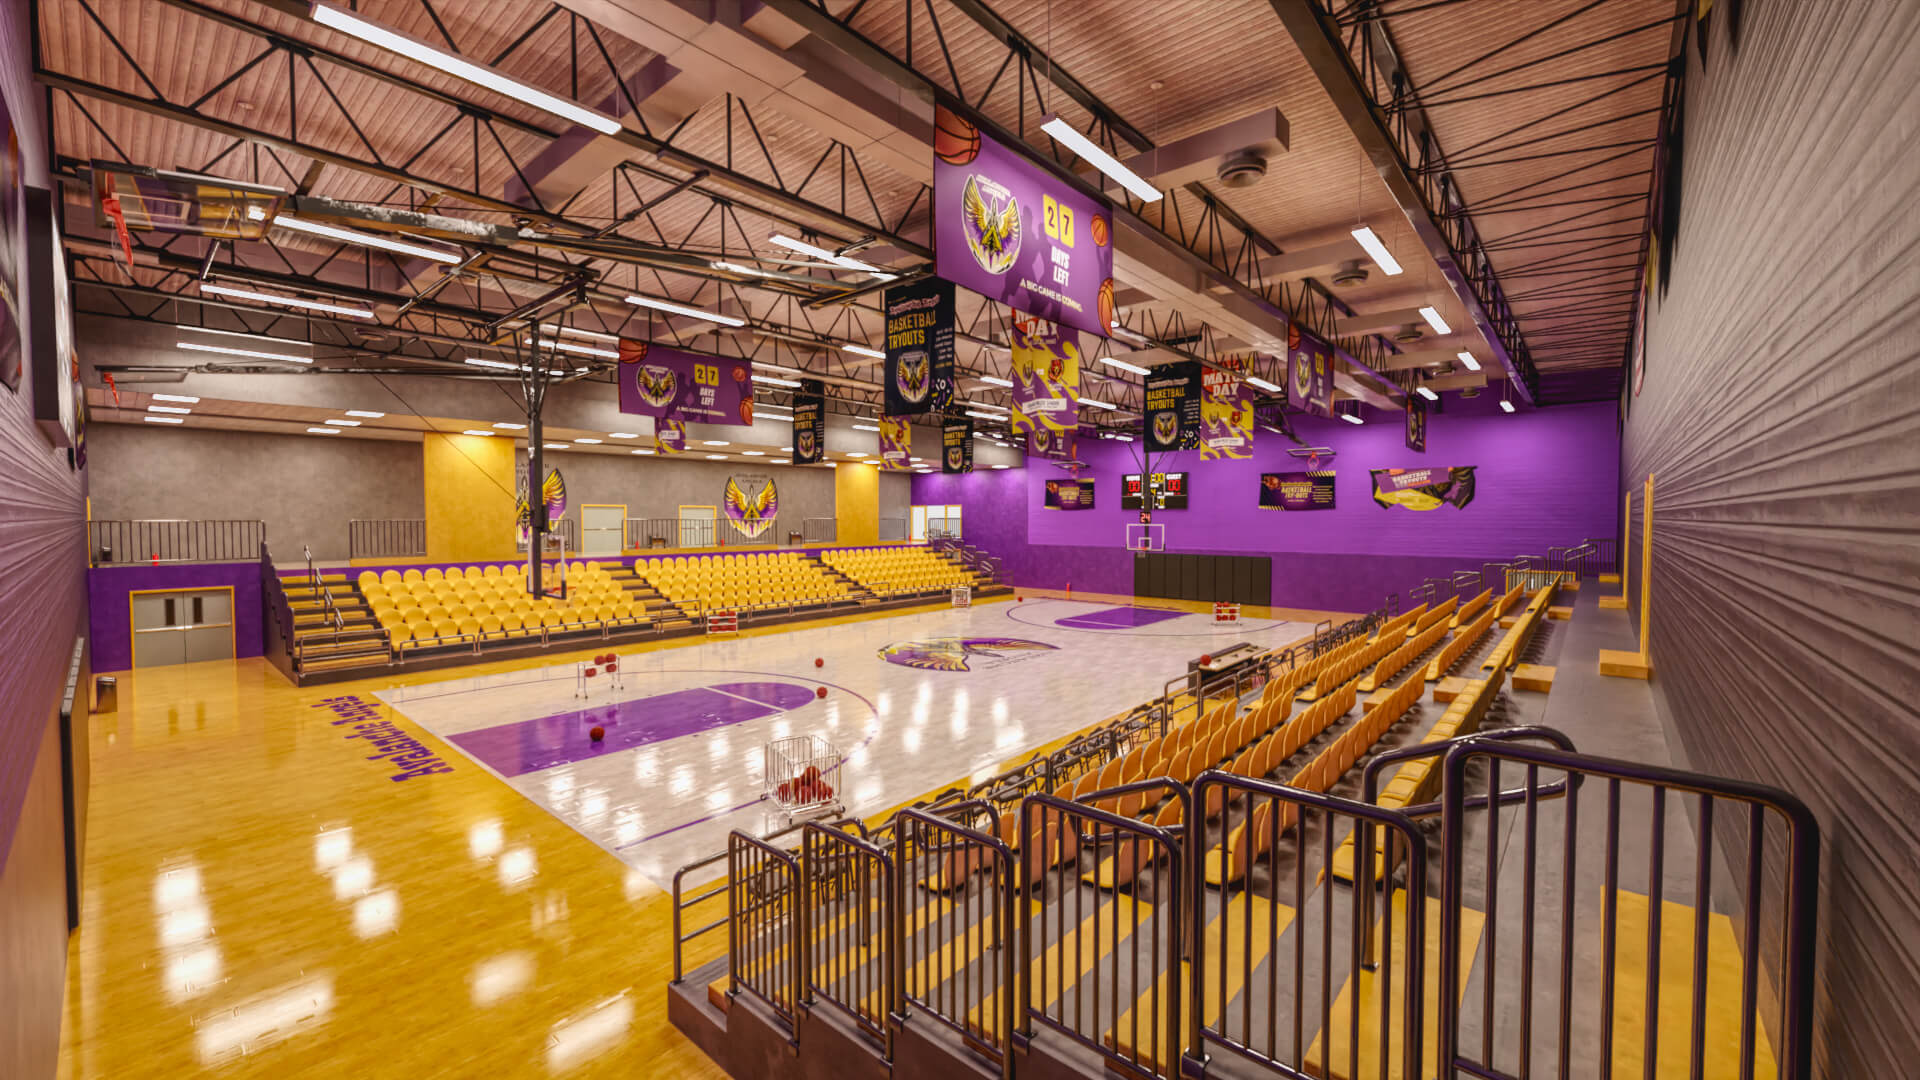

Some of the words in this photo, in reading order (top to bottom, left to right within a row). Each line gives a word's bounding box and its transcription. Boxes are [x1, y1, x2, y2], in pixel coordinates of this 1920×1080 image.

[1051, 246, 1070, 269] DAYS
[1053, 265, 1070, 287] LEFT
[1019, 278, 1027, 288] A
[1026, 280, 1038, 293] BIG
[1038, 285, 1056, 300] GAME
[1056, 293, 1062, 302] IS
[888, 310, 936, 334] BASKETBALL
[1027, 319, 1058, 338] DAY
[888, 329, 925, 351] TRYOUTS
[699, 387, 715, 397] DAYS
[1147, 387, 1185, 401] BASKETBALL
[1213, 383, 1239, 397] DAY
[701, 397, 715, 407] LEFT
[1147, 398, 1175, 411] TRYOUTS
[1128, 481, 1141, 492] 00
[1168, 480, 1181, 491] 00
[1140, 512, 1151, 523] 24
[345, 720, 455, 783] Avalanche
